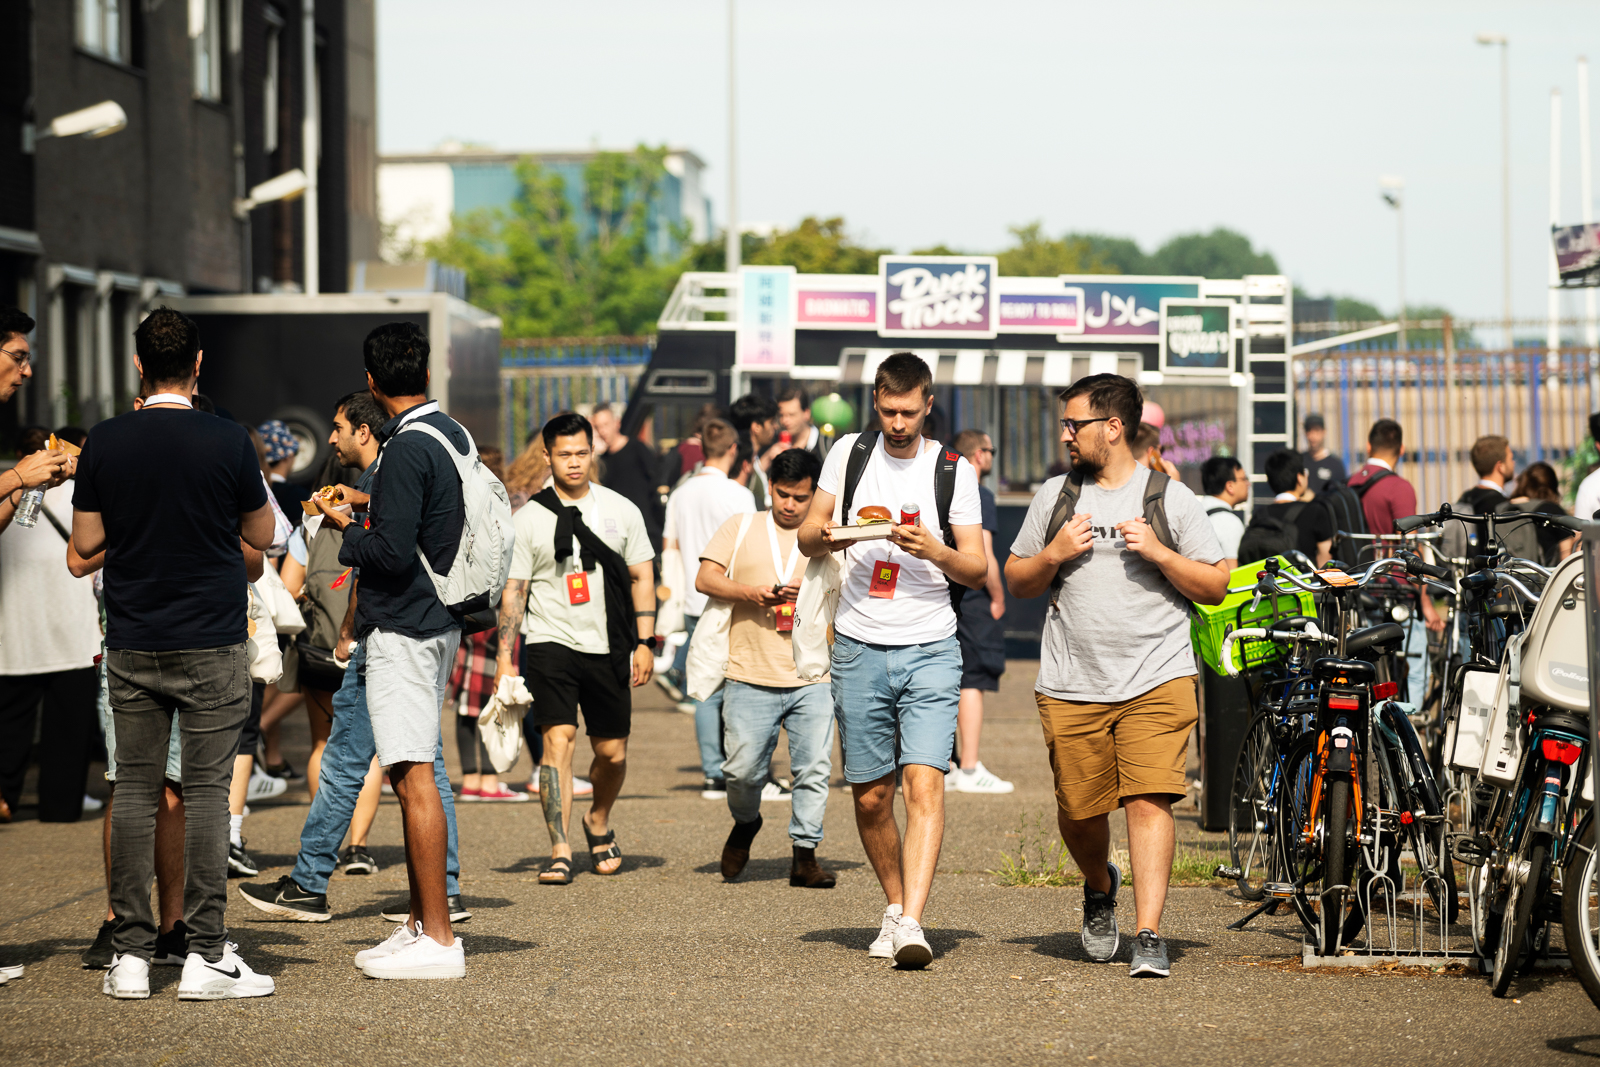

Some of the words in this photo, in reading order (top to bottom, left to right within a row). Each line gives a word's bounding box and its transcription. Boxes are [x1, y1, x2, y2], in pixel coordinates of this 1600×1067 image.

[888, 263, 987, 300] Duck
[888, 294, 985, 329] Truck
[1000, 302, 1035, 319] READY
[1036, 302, 1051, 319] TO
[1052, 302, 1077, 320] ROLL
[1085, 290, 1160, 329] حلال
